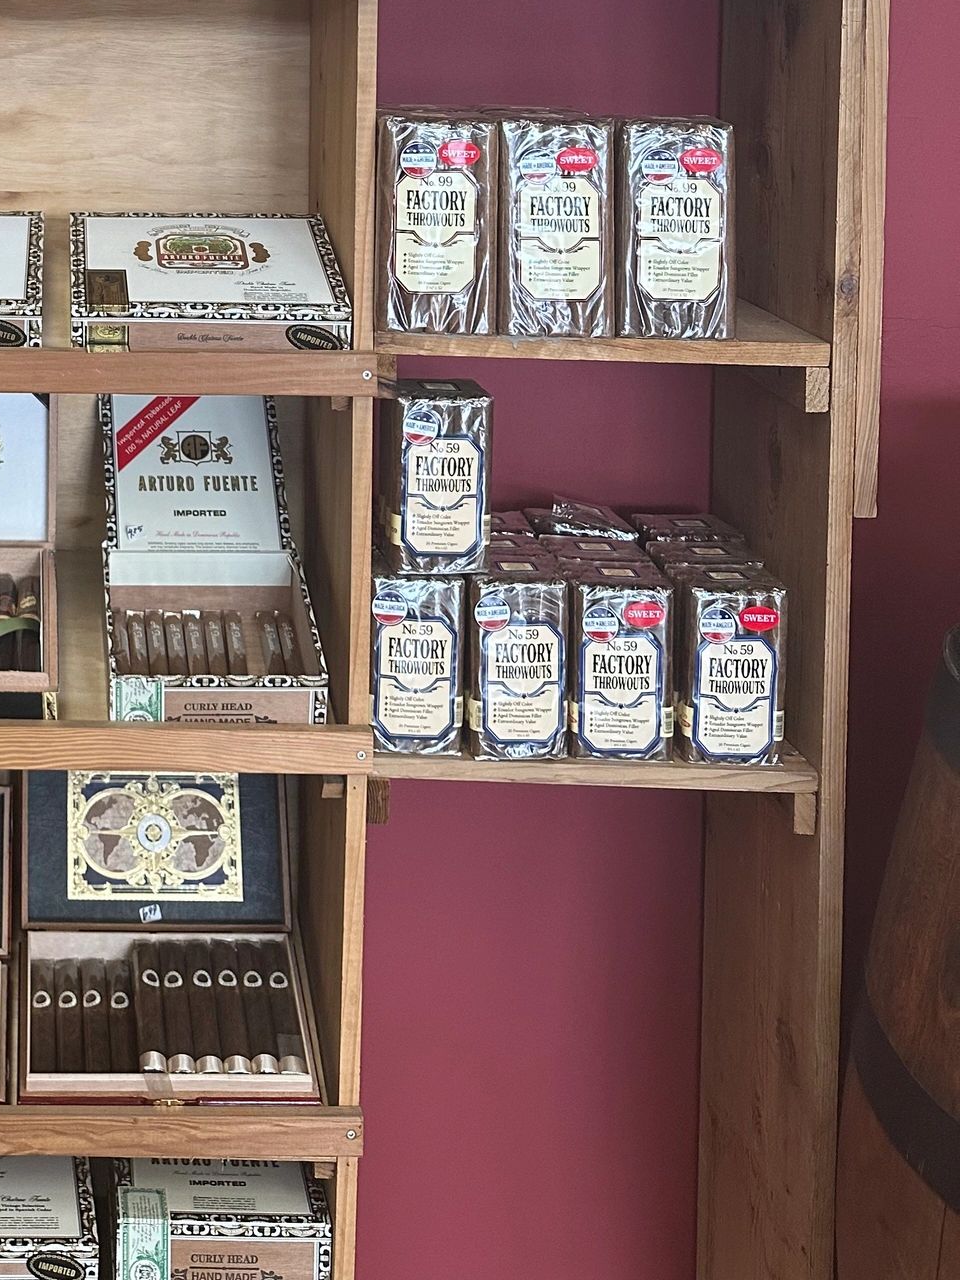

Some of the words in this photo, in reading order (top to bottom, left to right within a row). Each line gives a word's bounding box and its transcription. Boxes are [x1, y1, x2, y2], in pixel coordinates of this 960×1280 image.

[442, 149, 476, 158] SWEET
[560, 157, 593, 165] SWEET
[683, 157, 717, 165] SWEET
[438, 176, 453, 187] 99
[406, 189, 467, 210] FACTORY
[530, 196, 591, 217] FACTORY
[651, 197, 712, 218] FACTORY
[407, 211, 465, 227] THROWOUTS
[651, 218, 710, 234] THROWOUTS
[297, 331, 333, 350] IMPORTED
[125, 443, 137, 455] 100
[142, 414, 169, 440] NATURAL
[167, 400, 184, 418] LEAF
[445, 442, 460, 454] 59
[415, 456, 474, 477] FACTORY
[138, 475, 195, 492] ARTURO
[204, 475, 259, 492] FUENTE
[416, 478, 472, 492] THROWOUTS
[173, 509, 227, 517] IMPORTED
[628, 610, 661, 618] SWEET
[743, 614, 776, 623] SWEET
[402, 624, 416, 635] No
[419, 625, 433, 635] 59
[508, 629, 523, 639] No
[525, 629, 539, 640] 59
[389, 637, 447, 659] FACTORY
[495, 643, 553, 663] FACTORY
[606, 641, 621, 651] No
[623, 641, 638, 652] 59
[723, 644, 738, 655] No
[740, 644, 754, 655] 59
[389, 659, 445, 675] THROWOUTS
[495, 664, 552, 679] THROWOUTS
[592, 654, 652, 675] FACTORY
[709, 658, 768, 679] FACTORY
[593, 675, 650, 690] THROWOUTS
[709, 679, 765, 694] THROWOUTS
[184, 702, 219, 712] CURLY
[221, 702, 252, 711] HEAD
[189, 1179, 247, 1187] IMPORTED
[190, 1255, 224, 1264] CURLY
[227, 1255, 258, 1264] HEAD
[38, 1261, 76, 1277] IMPORTED
[191, 1272, 222, 1280] HAND
[225, 1272, 257, 1280] MADE
